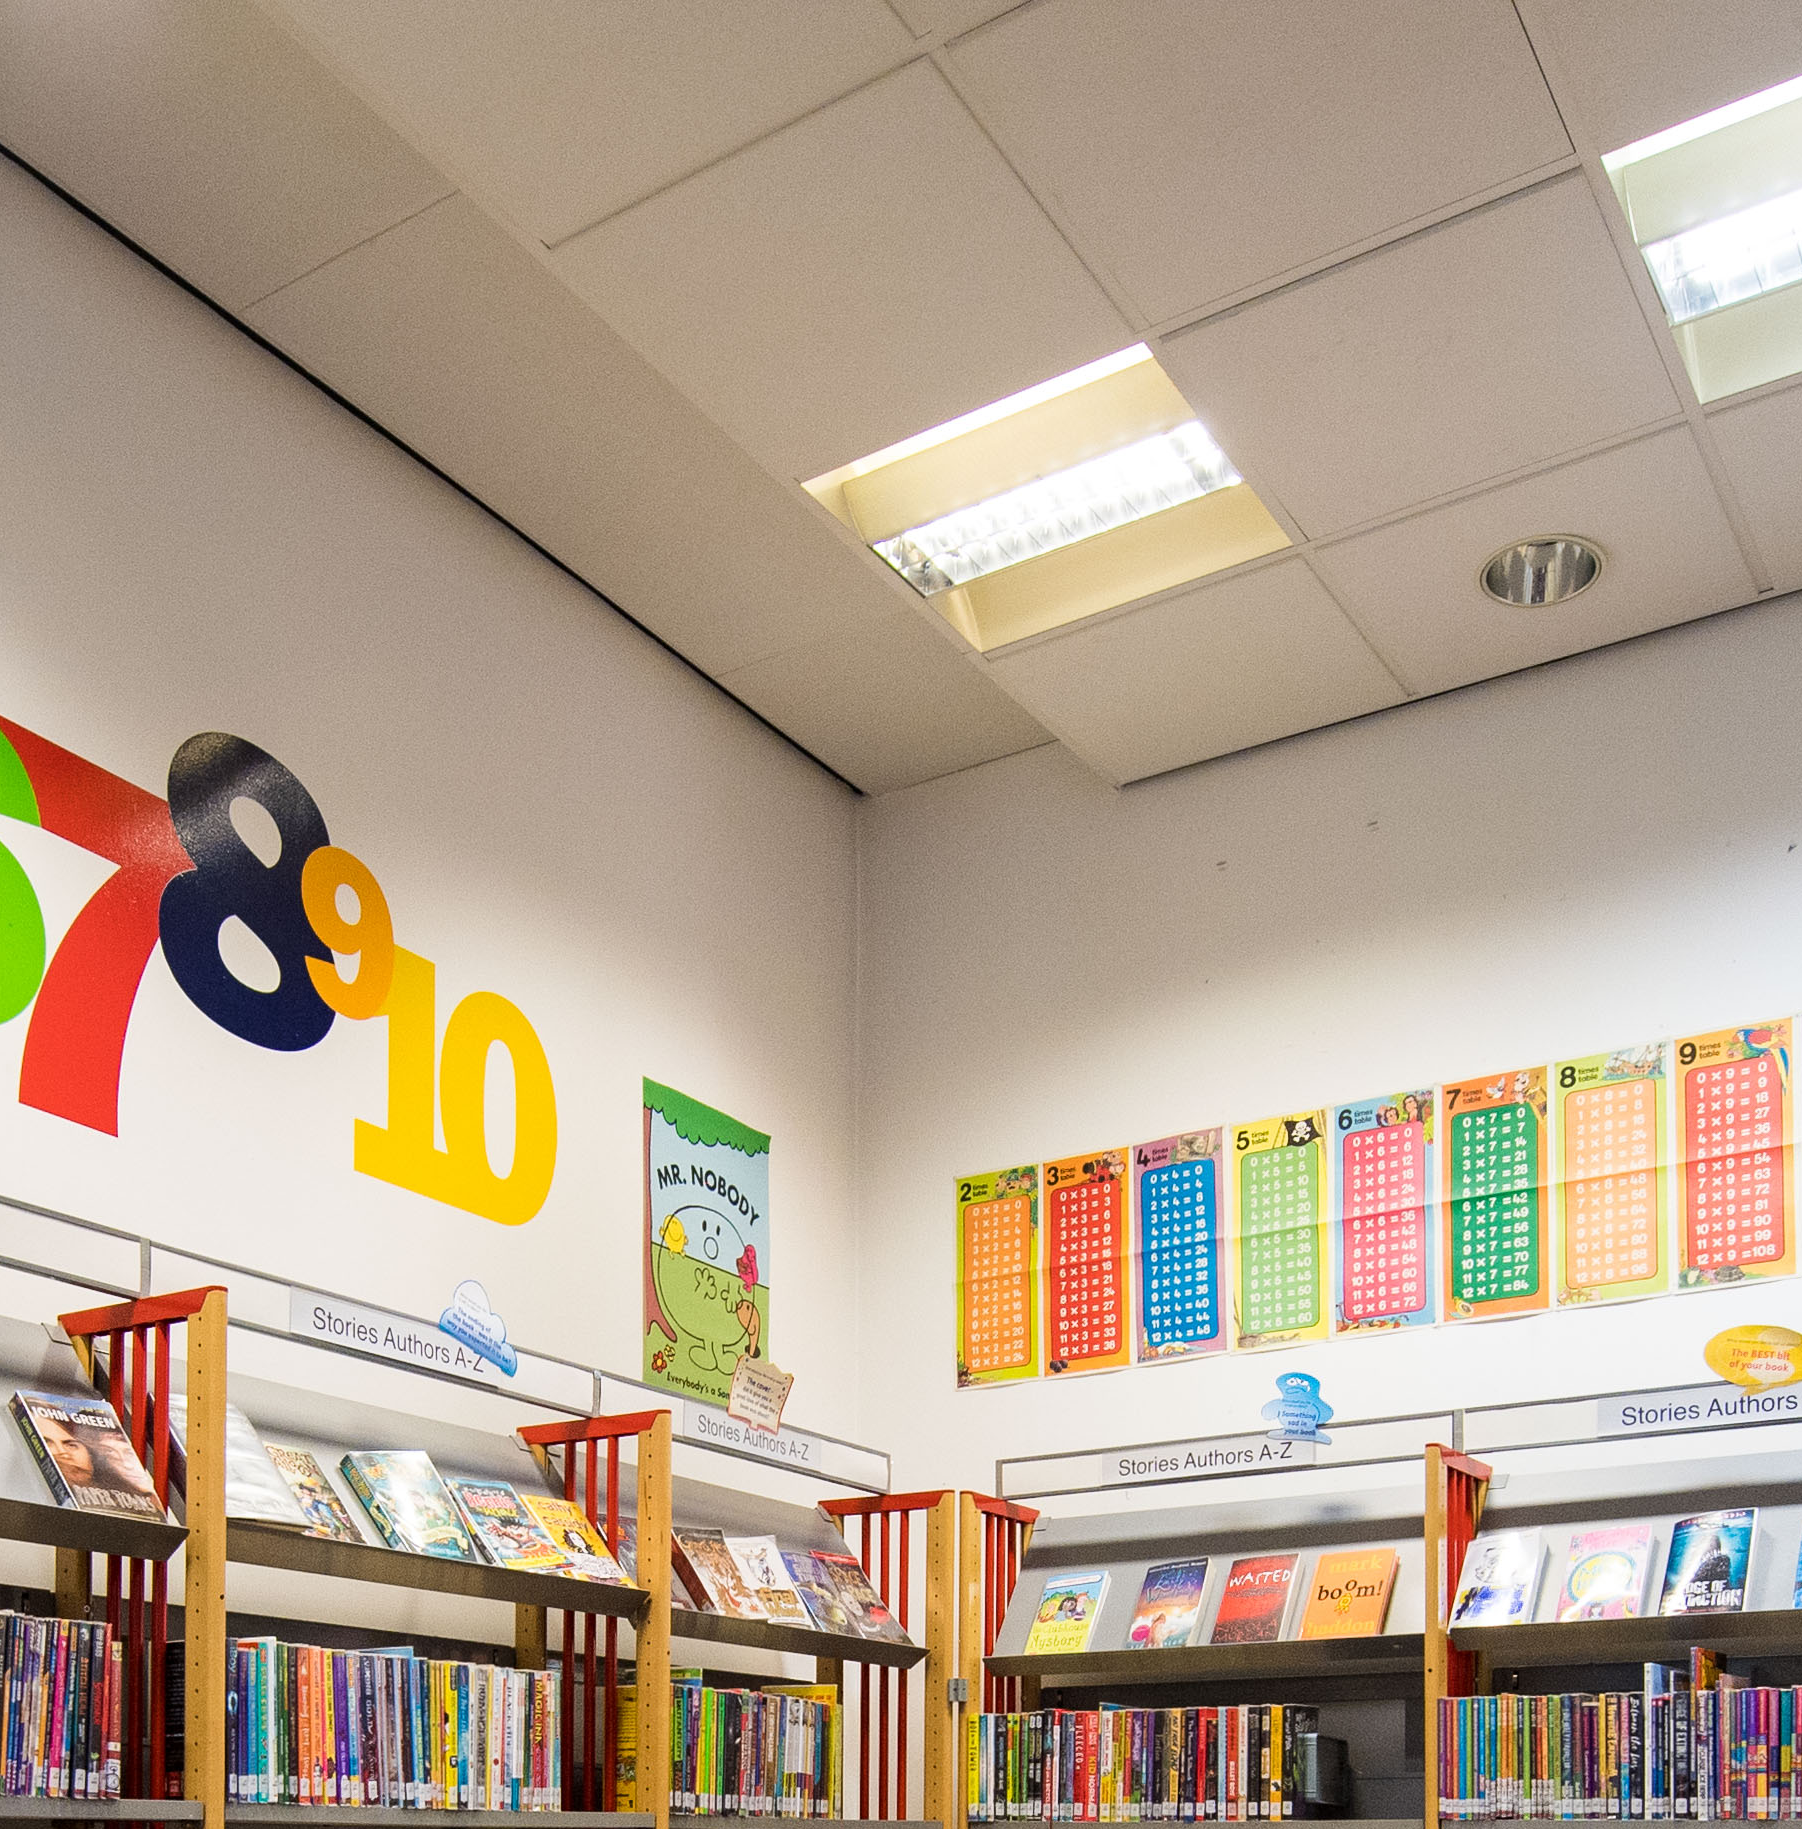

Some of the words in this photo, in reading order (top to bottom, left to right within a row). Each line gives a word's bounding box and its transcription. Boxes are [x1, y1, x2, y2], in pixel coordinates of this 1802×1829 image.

[159, 731, 337, 1053] 8
[303, 846, 393, 1020] 9
[1679, 1042, 1696, 1065] 9
[1699, 1042, 1721, 1051] times
[1699, 1051, 1720, 1060] table
[352, 945, 558, 1229] 10
[1560, 1066, 1576, 1088] 8
[1446, 1088, 1460, 1110] 7
[1338, 1109, 1352, 1130] 6
[1236, 1130, 1249, 1150] 5
[1137, 1149, 1150, 1168] 4
[1047, 1166, 1058, 1185] 3
[657, 1165, 687, 1190] MR.
[691, 1166, 760, 1227] NOBODY
[960, 1183, 971, 1202] 2
[313, 1307, 378, 1344] Stories
[384, 1328, 449, 1363] Authors
[1732, 1348, 1747, 1358] The
[1751, 1349, 1775, 1359] BEST
[1777, 1350, 1790, 1360] bit
[1729, 1360, 1740, 1369] of
[1741, 1361, 1762, 1373] your
[1765, 1361, 1789, 1372] book
[667, 1372, 708, 1394] Everybody's
[32, 1405, 70, 1425] JOHN
[70, 1411, 117, 1431] GREEN
[1282, 1411, 1316, 1421] Something
[1621, 1404, 1700, 1426] Stories
[1708, 1391, 1798, 1417] Authors
[697, 1415, 740, 1444] Stories
[743, 1429, 787, 1455] Authors
[790, 1439, 809, 1461] A-Z
[1119, 1456, 1178, 1476] Stories
[1184, 1449, 1253, 1470] Authors
[1259, 1441, 1293, 1461] A-Z
[1229, 1569, 1289, 1588] WASTED
[1317, 1579, 1384, 1602] boom!
